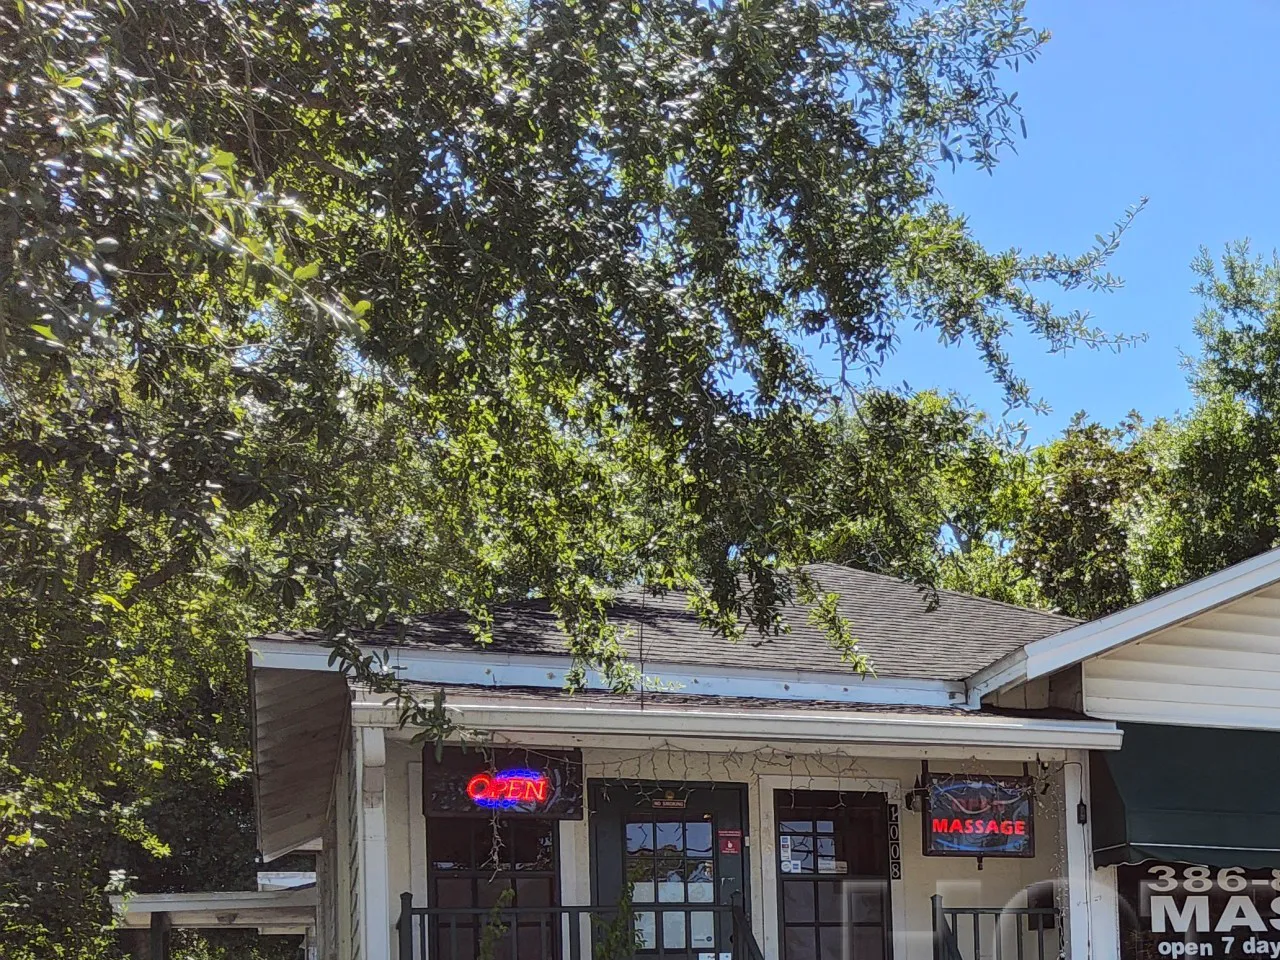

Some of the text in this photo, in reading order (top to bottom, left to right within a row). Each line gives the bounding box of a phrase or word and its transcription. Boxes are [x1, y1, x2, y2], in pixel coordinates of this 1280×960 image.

[467, 774, 547, 802] OPEN
[932, 818, 1026, 835] MASSAGE
[1157, 940, 1214, 960] open
[1221, 936, 1235, 955] 7
